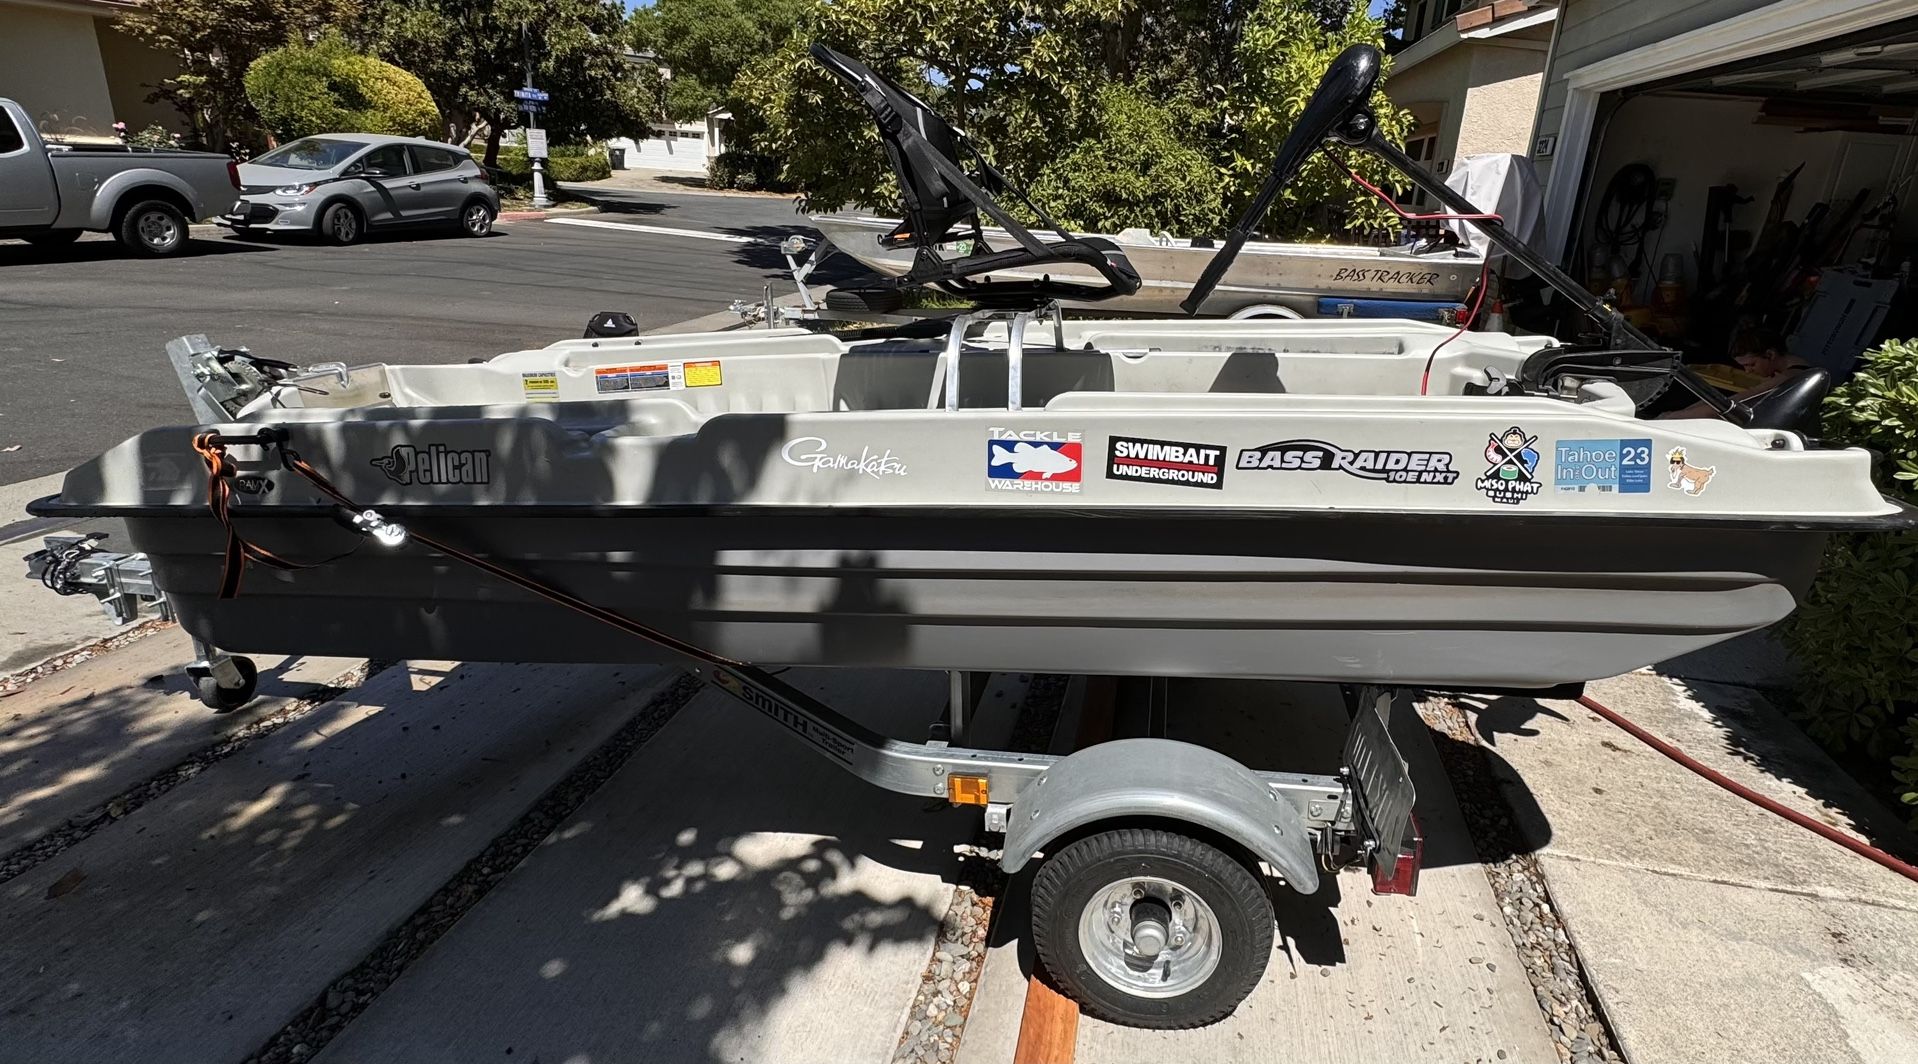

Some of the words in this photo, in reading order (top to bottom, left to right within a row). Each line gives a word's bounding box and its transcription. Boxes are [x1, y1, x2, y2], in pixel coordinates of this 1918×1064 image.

[1333, 268, 1371, 282] BASS
[1370, 269, 1440, 286] TRACKER
[988, 427, 1082, 442] TACKLE
[781, 436, 908, 480] Gamakatsu
[1114, 441, 1220, 466] SWIMBAIT
[1238, 450, 1324, 469] BASS
[1330, 450, 1451, 472] RAIDER
[1557, 447, 1616, 463] Tahoe
[1621, 446, 1650, 465] 23
[392, 444, 490, 486] Pelican
[1557, 464, 1574, 480] In
[1581, 464, 1617, 480] Out
[1112, 466, 1218, 484] UNDERGROUND
[1387, 471, 1419, 482] 10E
[1420, 471, 1458, 483] NXT
[989, 479, 1081, 493] WAREHOUSE
[1477, 479, 1506, 490] MISO
[1508, 480, 1541, 494] PHAT
